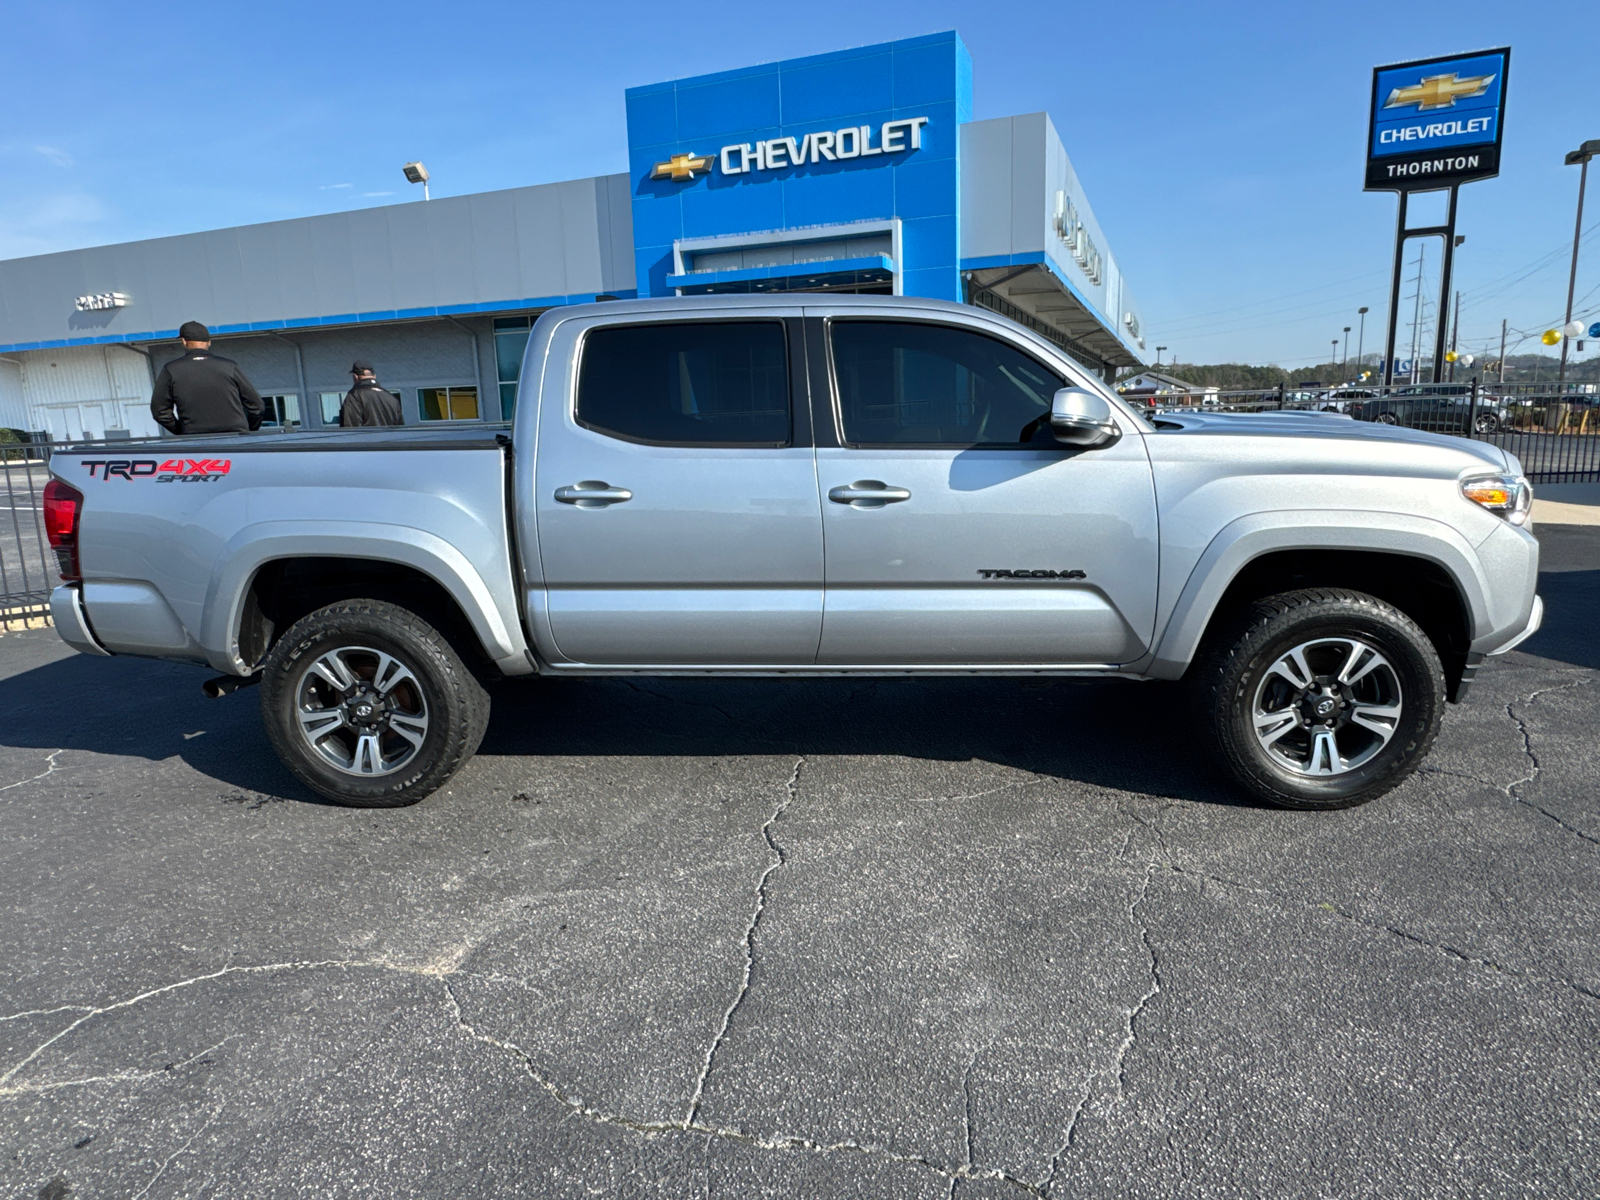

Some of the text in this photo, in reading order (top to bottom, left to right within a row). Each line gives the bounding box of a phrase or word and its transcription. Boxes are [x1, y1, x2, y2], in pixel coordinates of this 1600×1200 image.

[1380, 117, 1492, 144] CHEVROLET
[720, 116, 929, 175] CHEVROLET
[1387, 155, 1479, 177] THORNTON
[81, 460, 158, 482] TRD
[155, 474, 226, 483] SPORT
[977, 569, 1087, 579] TACOMA
